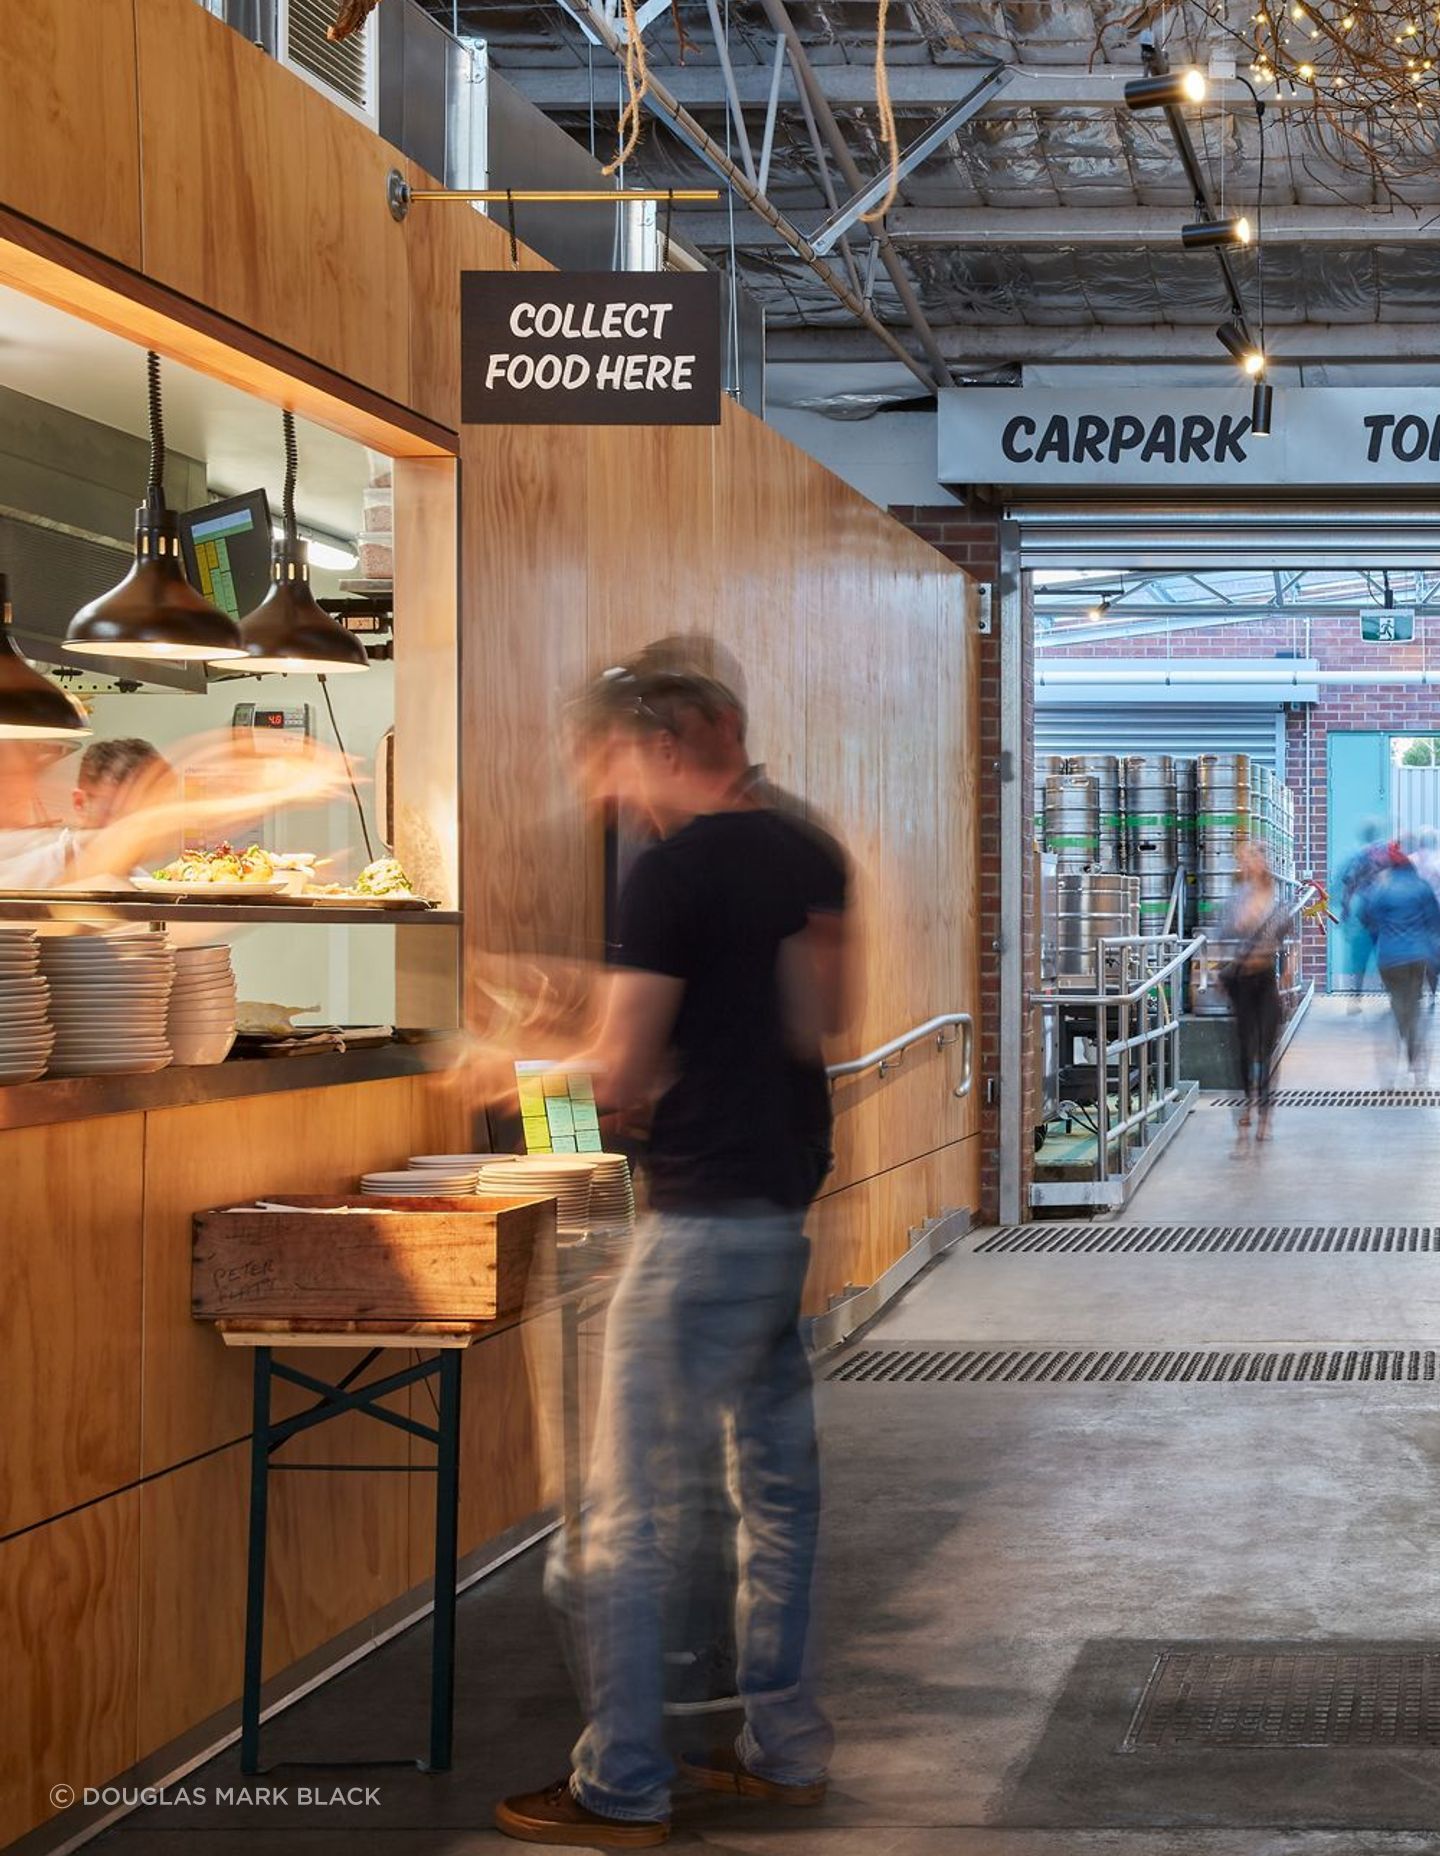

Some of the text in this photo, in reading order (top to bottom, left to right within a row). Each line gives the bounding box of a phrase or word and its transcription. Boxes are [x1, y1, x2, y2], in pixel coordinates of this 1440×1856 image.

[509, 302, 673, 340] COLLECT
[485, 353, 696, 391] FOOD HERE
[1001, 413, 1255, 464] CARPARK
